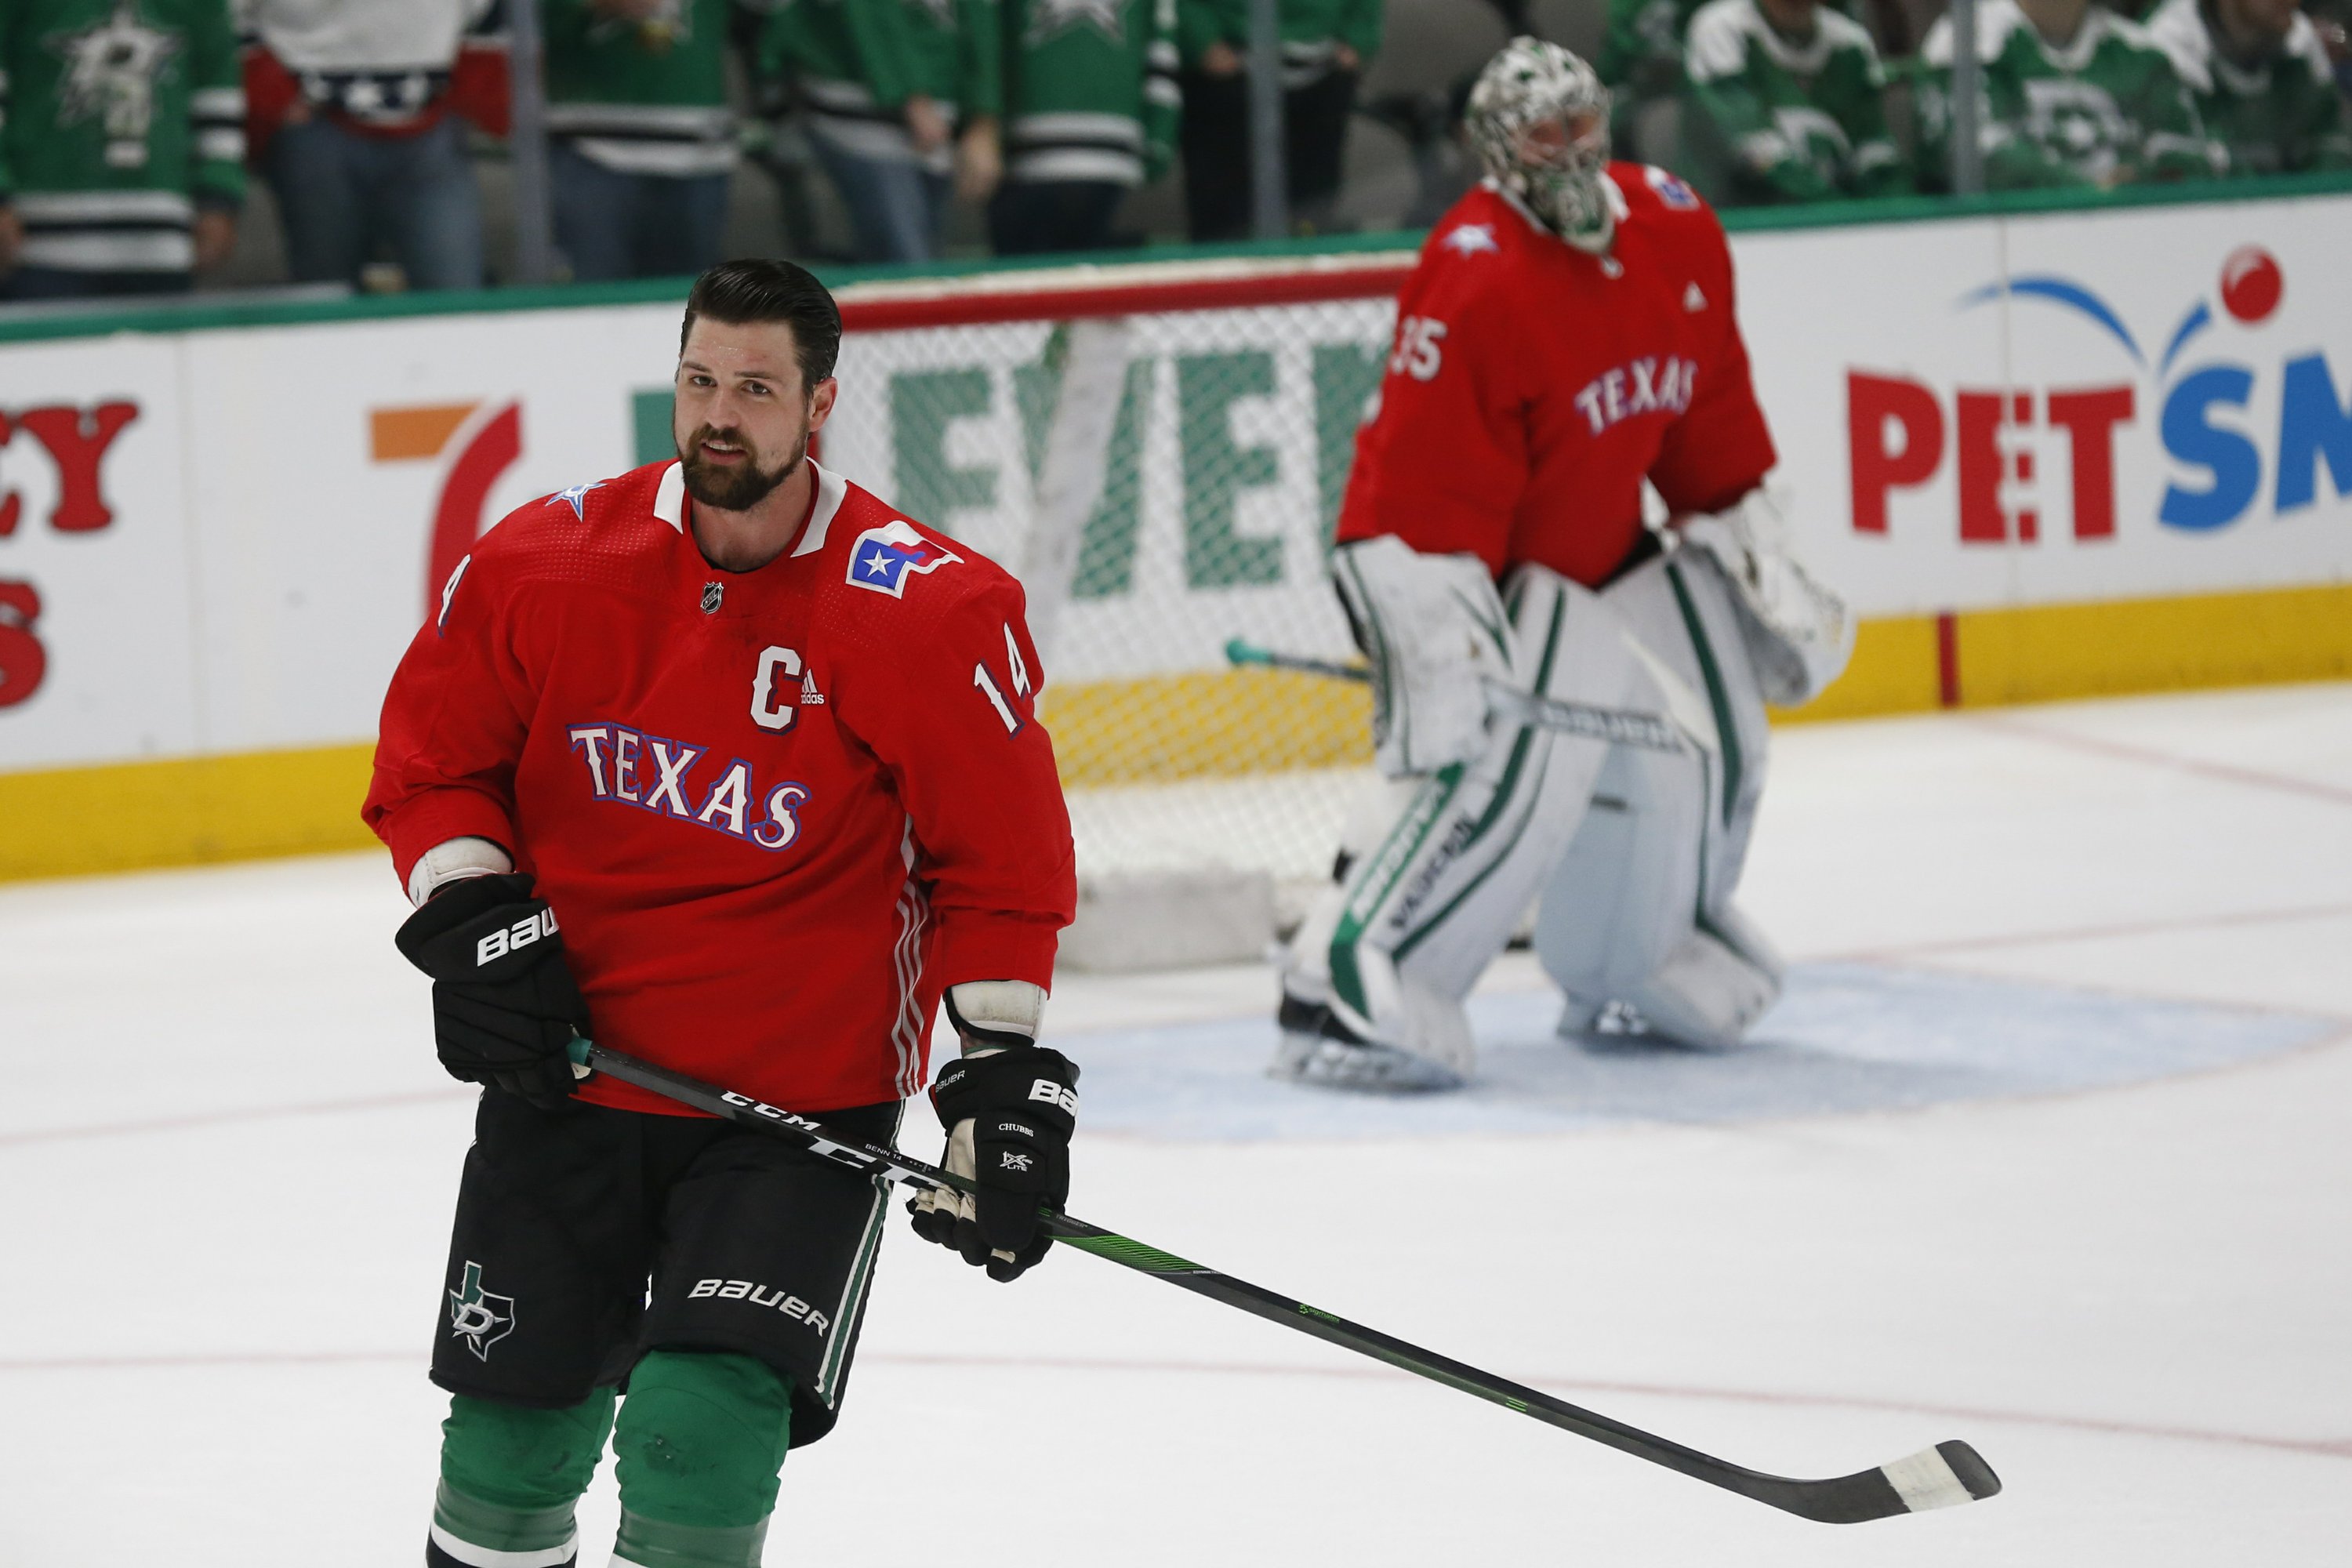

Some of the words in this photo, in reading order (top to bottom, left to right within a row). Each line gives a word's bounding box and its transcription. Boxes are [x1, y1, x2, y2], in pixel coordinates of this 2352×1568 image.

[1574, 355, 1699, 437] TEXAS
[0, 400, 140, 536] Y
[750, 645, 806, 735] C
[974, 621, 1031, 740] 14
[566, 721, 812, 852] TEXAS
[720, 1090, 822, 1131] CCM
[998, 1123, 1034, 1137] CHUBBS
[808, 1136, 975, 1196] CC
[865, 1143, 891, 1156] BENN
[687, 1279, 829, 1338] BAUER
